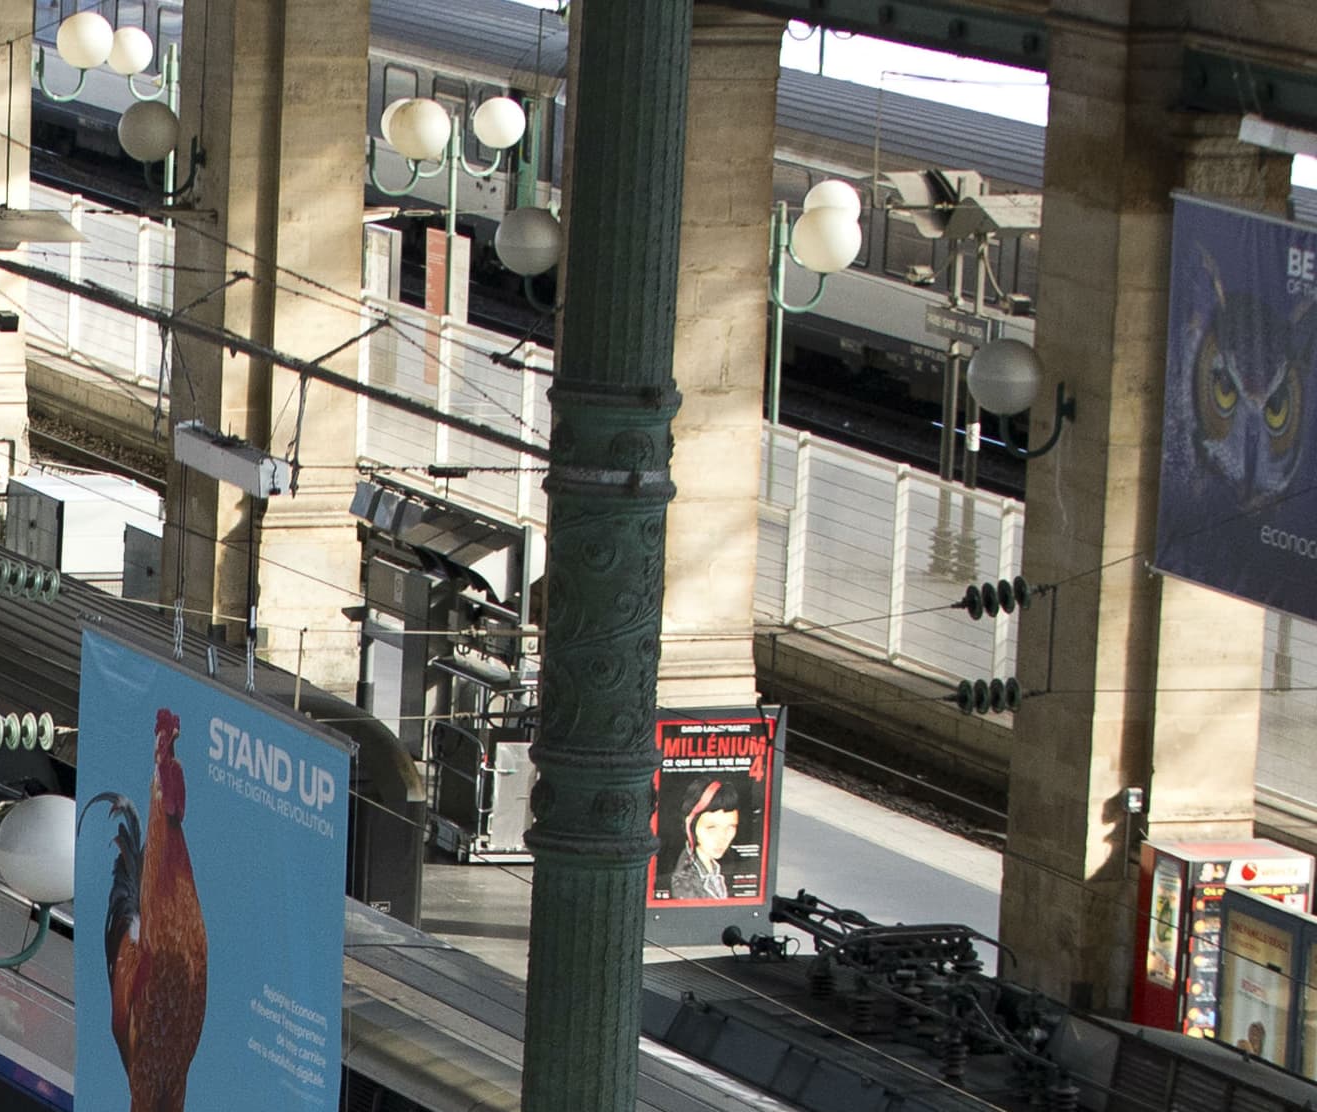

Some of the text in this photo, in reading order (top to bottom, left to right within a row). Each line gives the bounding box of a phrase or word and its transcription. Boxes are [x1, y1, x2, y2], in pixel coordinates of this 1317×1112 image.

[1287, 247, 1315, 281] BE
[663, 734, 767, 757] MILLÉNIUM
[209, 717, 335, 811] STAND UP
[749, 756, 764, 782] 4
[208, 763, 334, 839] FOR THE DIGITAL REVOLUTION
